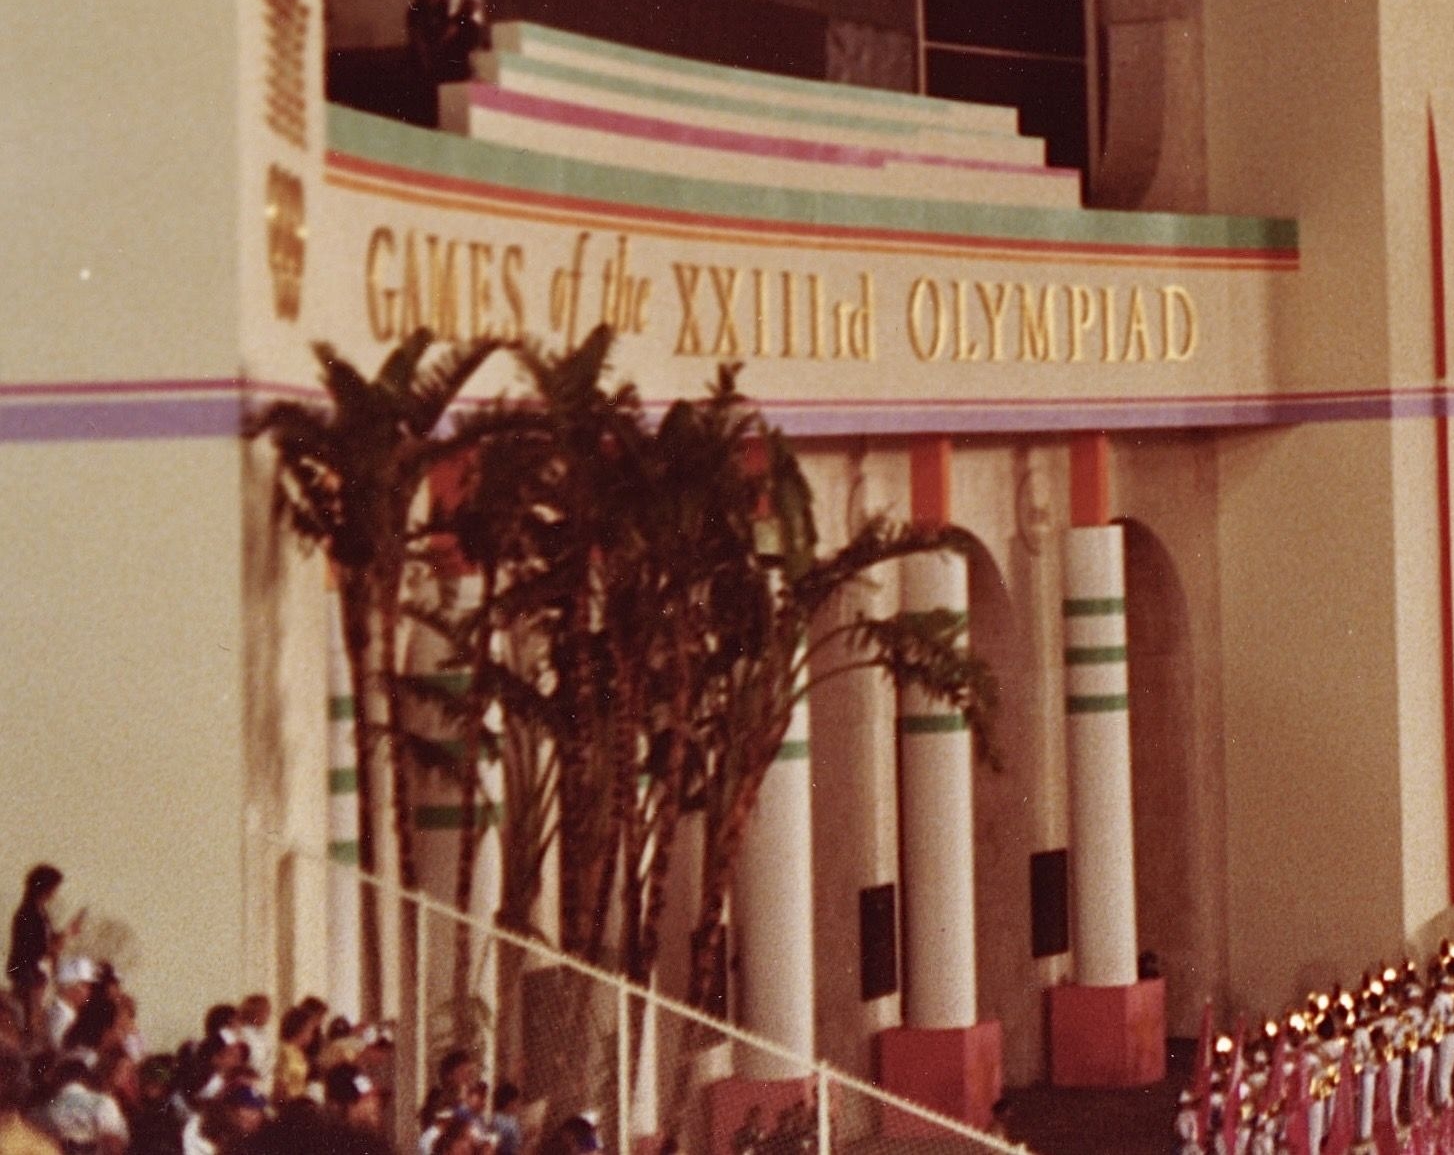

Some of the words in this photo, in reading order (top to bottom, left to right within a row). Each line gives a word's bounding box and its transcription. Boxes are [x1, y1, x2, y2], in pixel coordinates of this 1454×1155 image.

[365, 226, 525, 343] GAMES
[549, 231, 591, 355] of
[600, 235, 651, 335] the
[907, 275, 1198, 362] OLYMPIAD
